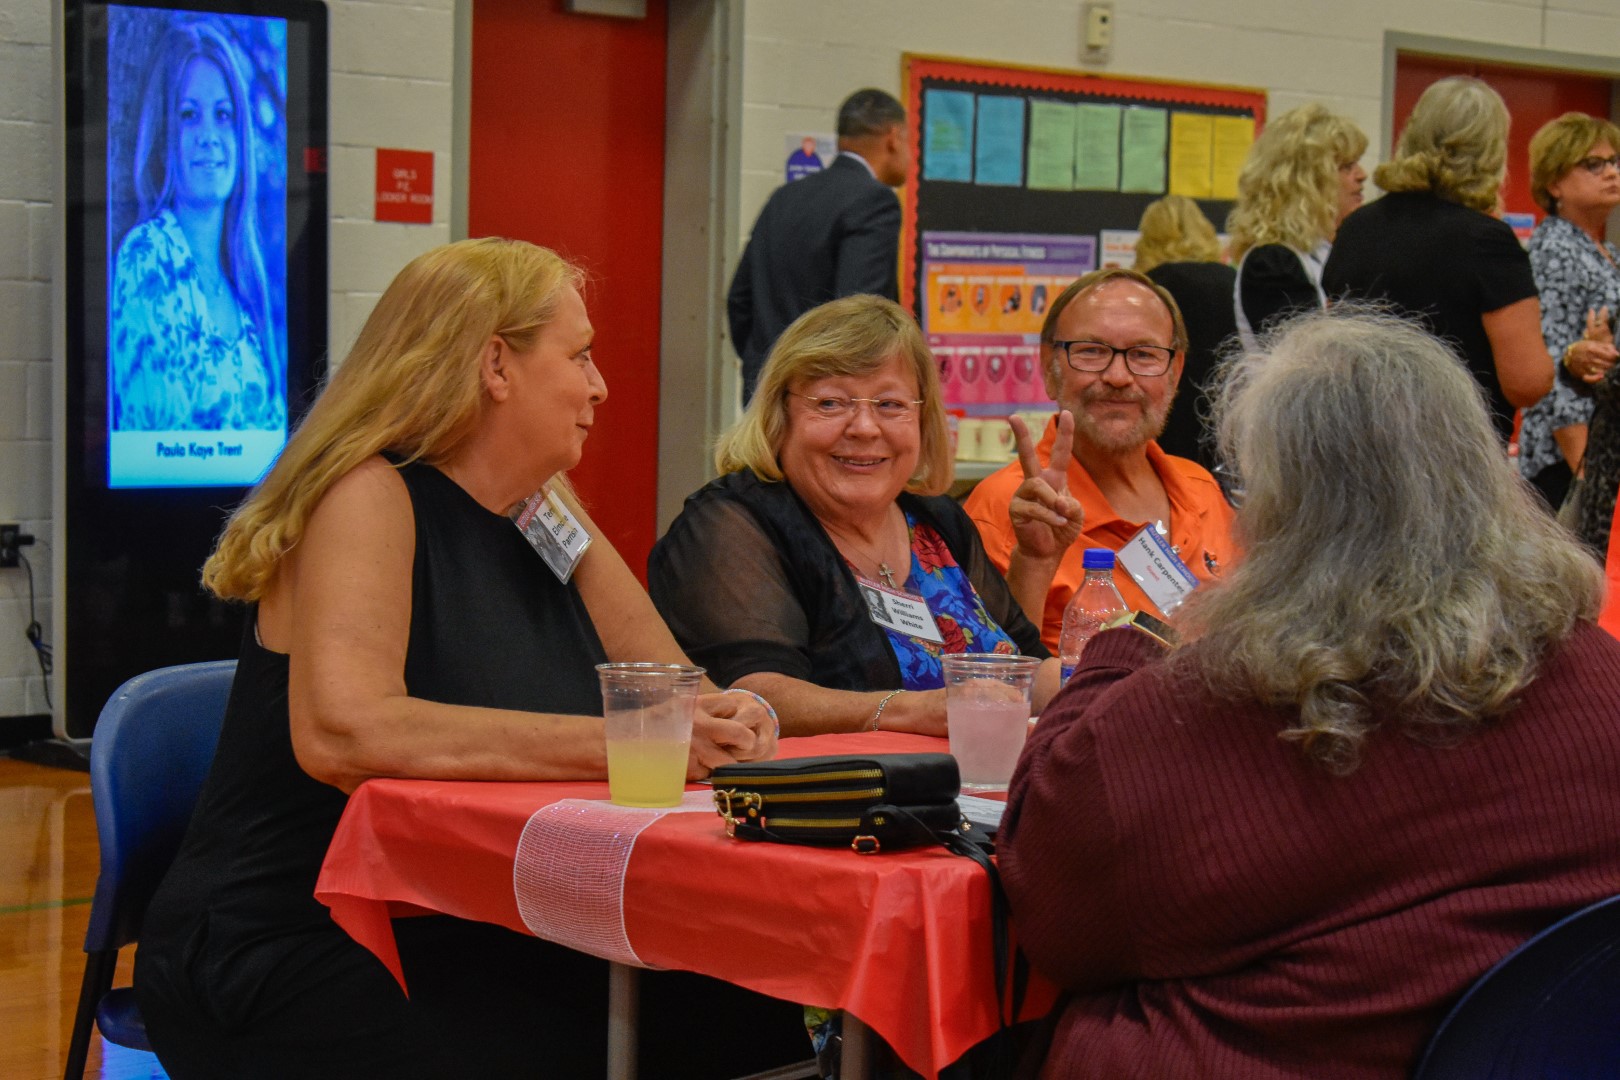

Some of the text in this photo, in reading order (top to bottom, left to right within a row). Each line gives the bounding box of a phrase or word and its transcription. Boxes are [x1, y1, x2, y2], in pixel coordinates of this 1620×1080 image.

[156, 441, 243, 460] Paula Kaye Trent
[1148, 525, 1196, 585] BUTLER HIGH SCHOOL
[1138, 536, 1185, 594] Hank Carpenter
[891, 598, 915, 610] Sherri
[891, 606, 924, 621] Williams
[899, 618, 924, 630] White
